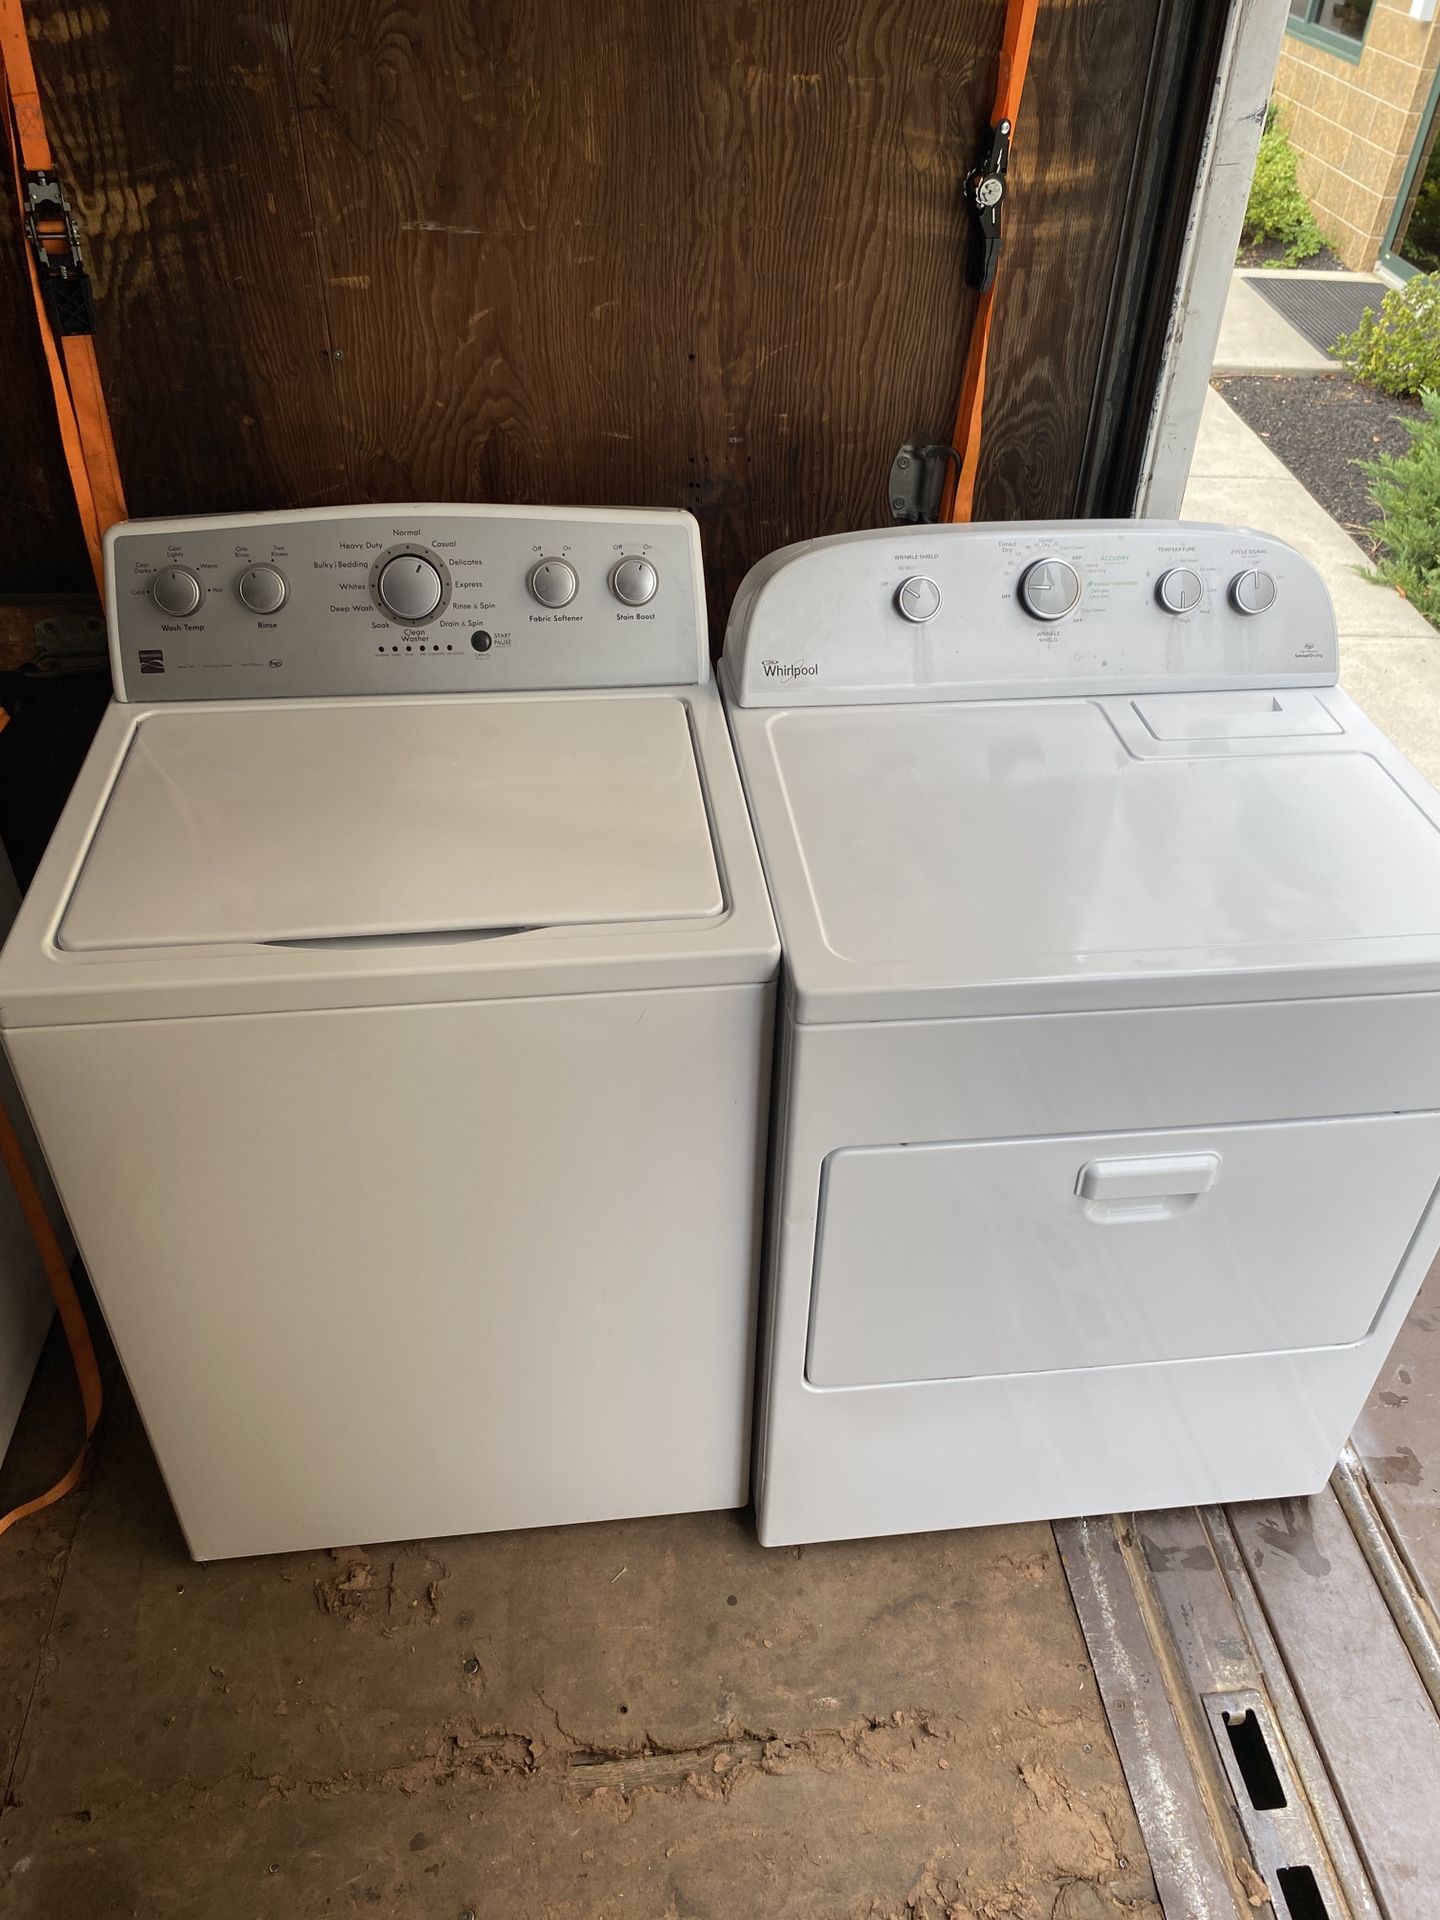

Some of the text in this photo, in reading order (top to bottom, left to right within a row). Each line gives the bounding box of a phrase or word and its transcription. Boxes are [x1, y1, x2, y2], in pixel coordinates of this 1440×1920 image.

[339, 541, 383, 551] Heavy Duty
[431, 540, 457, 548] Casual
[313, 560, 369, 569] Bulky Bedding
[448, 558, 483, 566] Delicates
[339, 583, 366, 591] Whites
[454, 581, 483, 589] Express
[330, 604, 374, 613] Deep Wash
[452, 602, 471, 610] Rinse
[480, 602, 496, 610] Spin
[529, 614, 584, 623] Fabric Softener
[616, 613, 635, 621] Stain
[161, 623, 205, 632] Wash Temp
[257, 621, 278, 629] Rinse
[371, 621, 390, 629] Soak
[467, 619, 484, 628] Spin
[403, 628, 426, 636] Clean
[401, 635, 430, 643] Washer
[763, 663, 818, 680] Whirlpool
